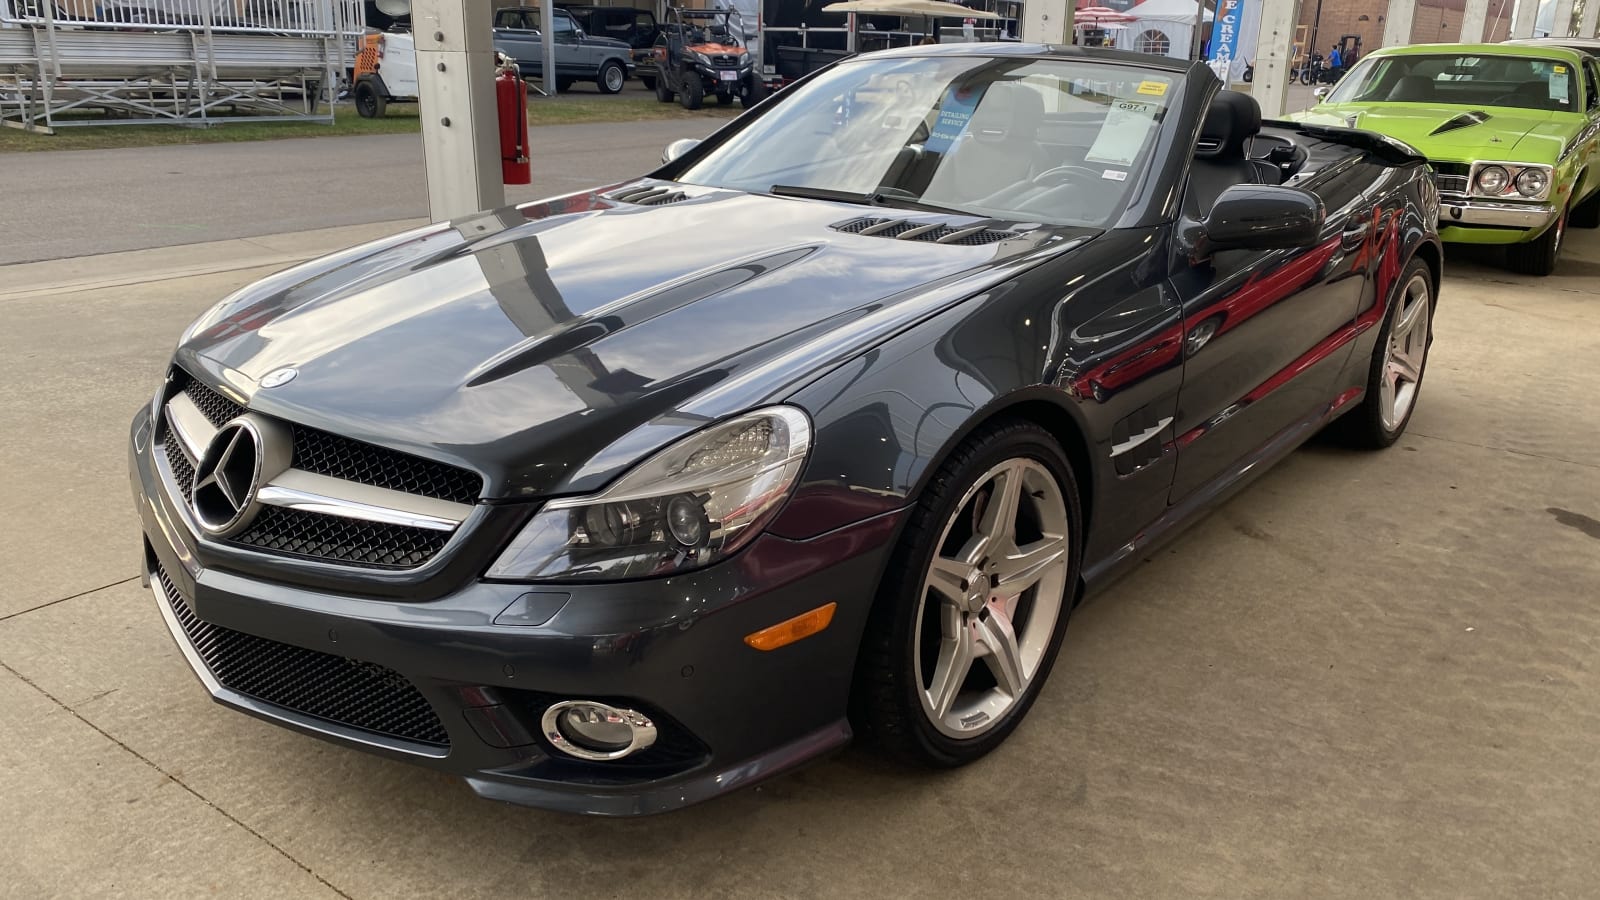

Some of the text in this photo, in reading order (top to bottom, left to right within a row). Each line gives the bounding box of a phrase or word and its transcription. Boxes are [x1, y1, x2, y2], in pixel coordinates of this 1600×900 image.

[1216, 14, 1236, 63] CREAM
[1119, 102, 1148, 112] G97.1
[940, 110, 970, 120] DETAILING
[942, 118, 964, 127] SERVICE
